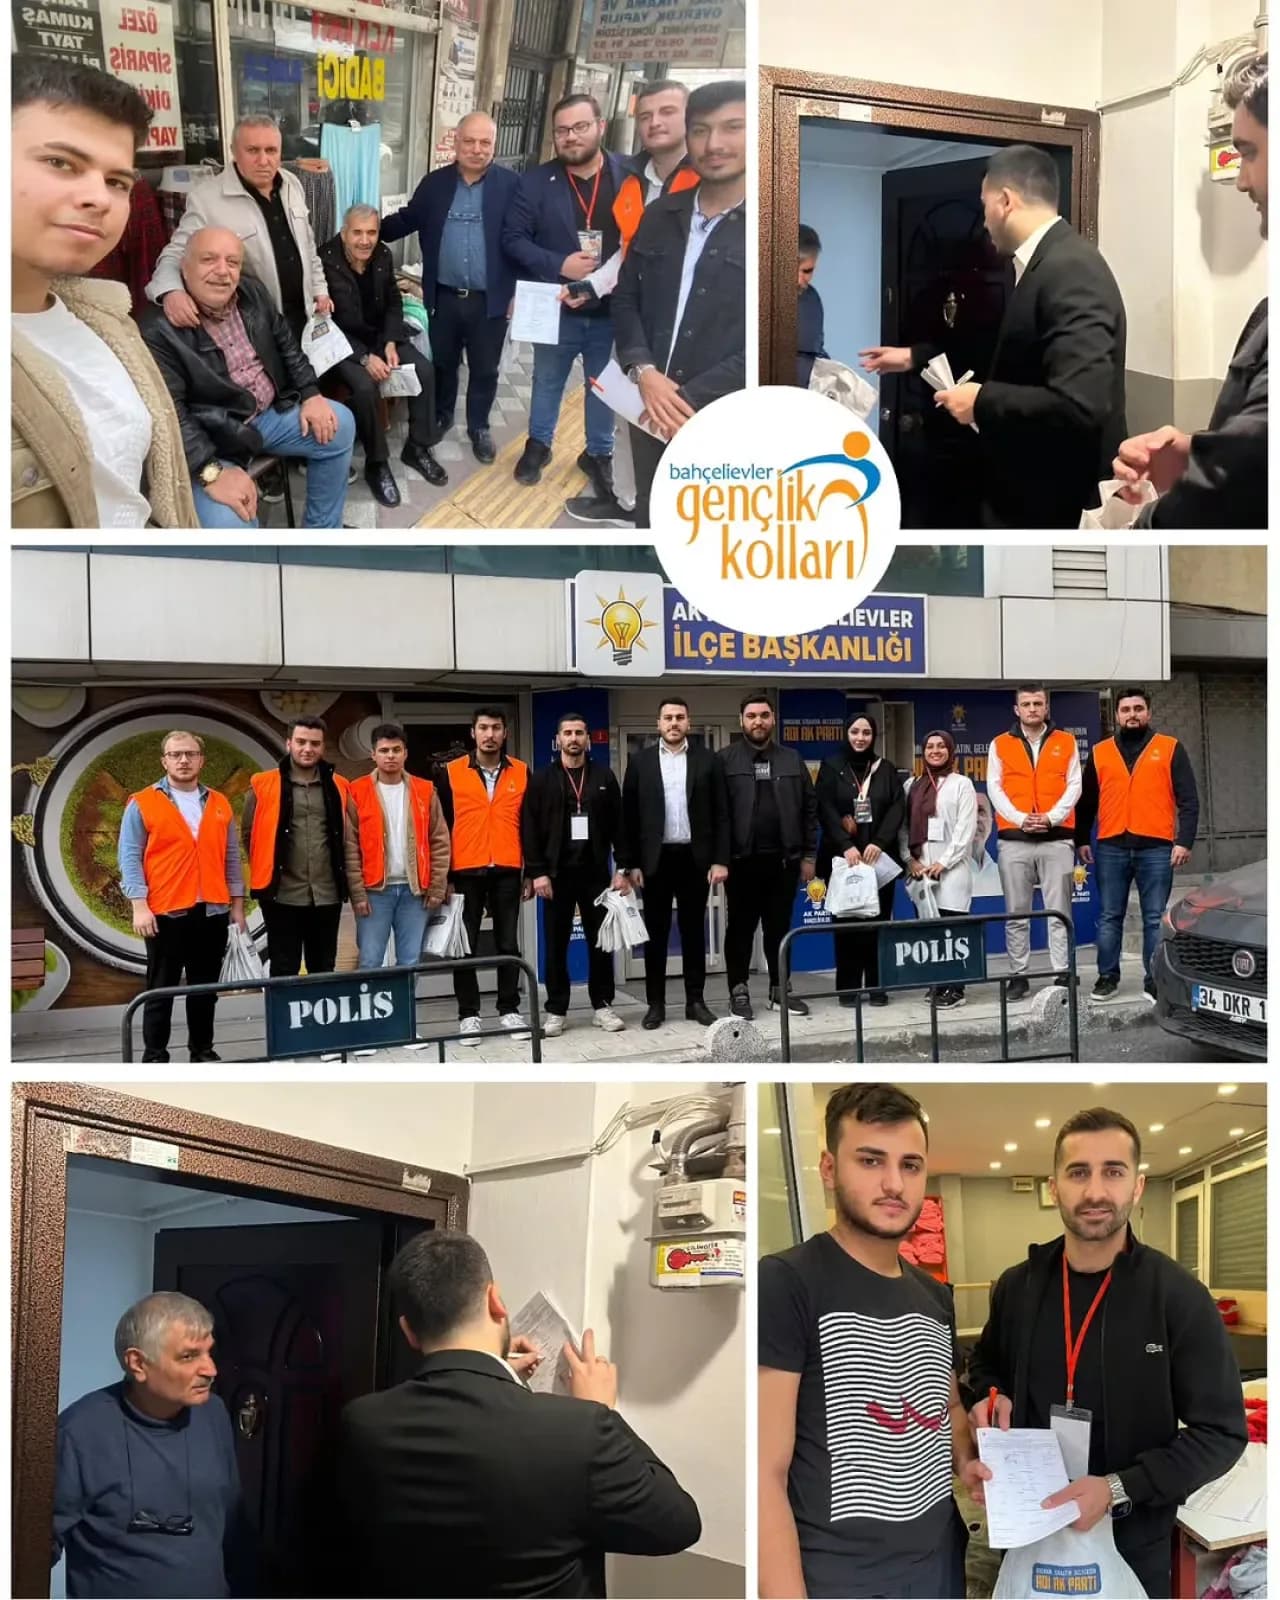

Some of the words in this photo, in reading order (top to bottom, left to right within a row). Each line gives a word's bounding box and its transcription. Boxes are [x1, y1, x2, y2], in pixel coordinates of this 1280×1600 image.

[673, 624, 736, 665] İLÇE
[743, 630, 912, 666] BAŞKANLIĞI
[895, 928, 970, 966] POLİS
[288, 983, 394, 1029] POLİS
[1199, 987, 1217, 1009] 34
[1223, 992, 1250, 1017] DKR
